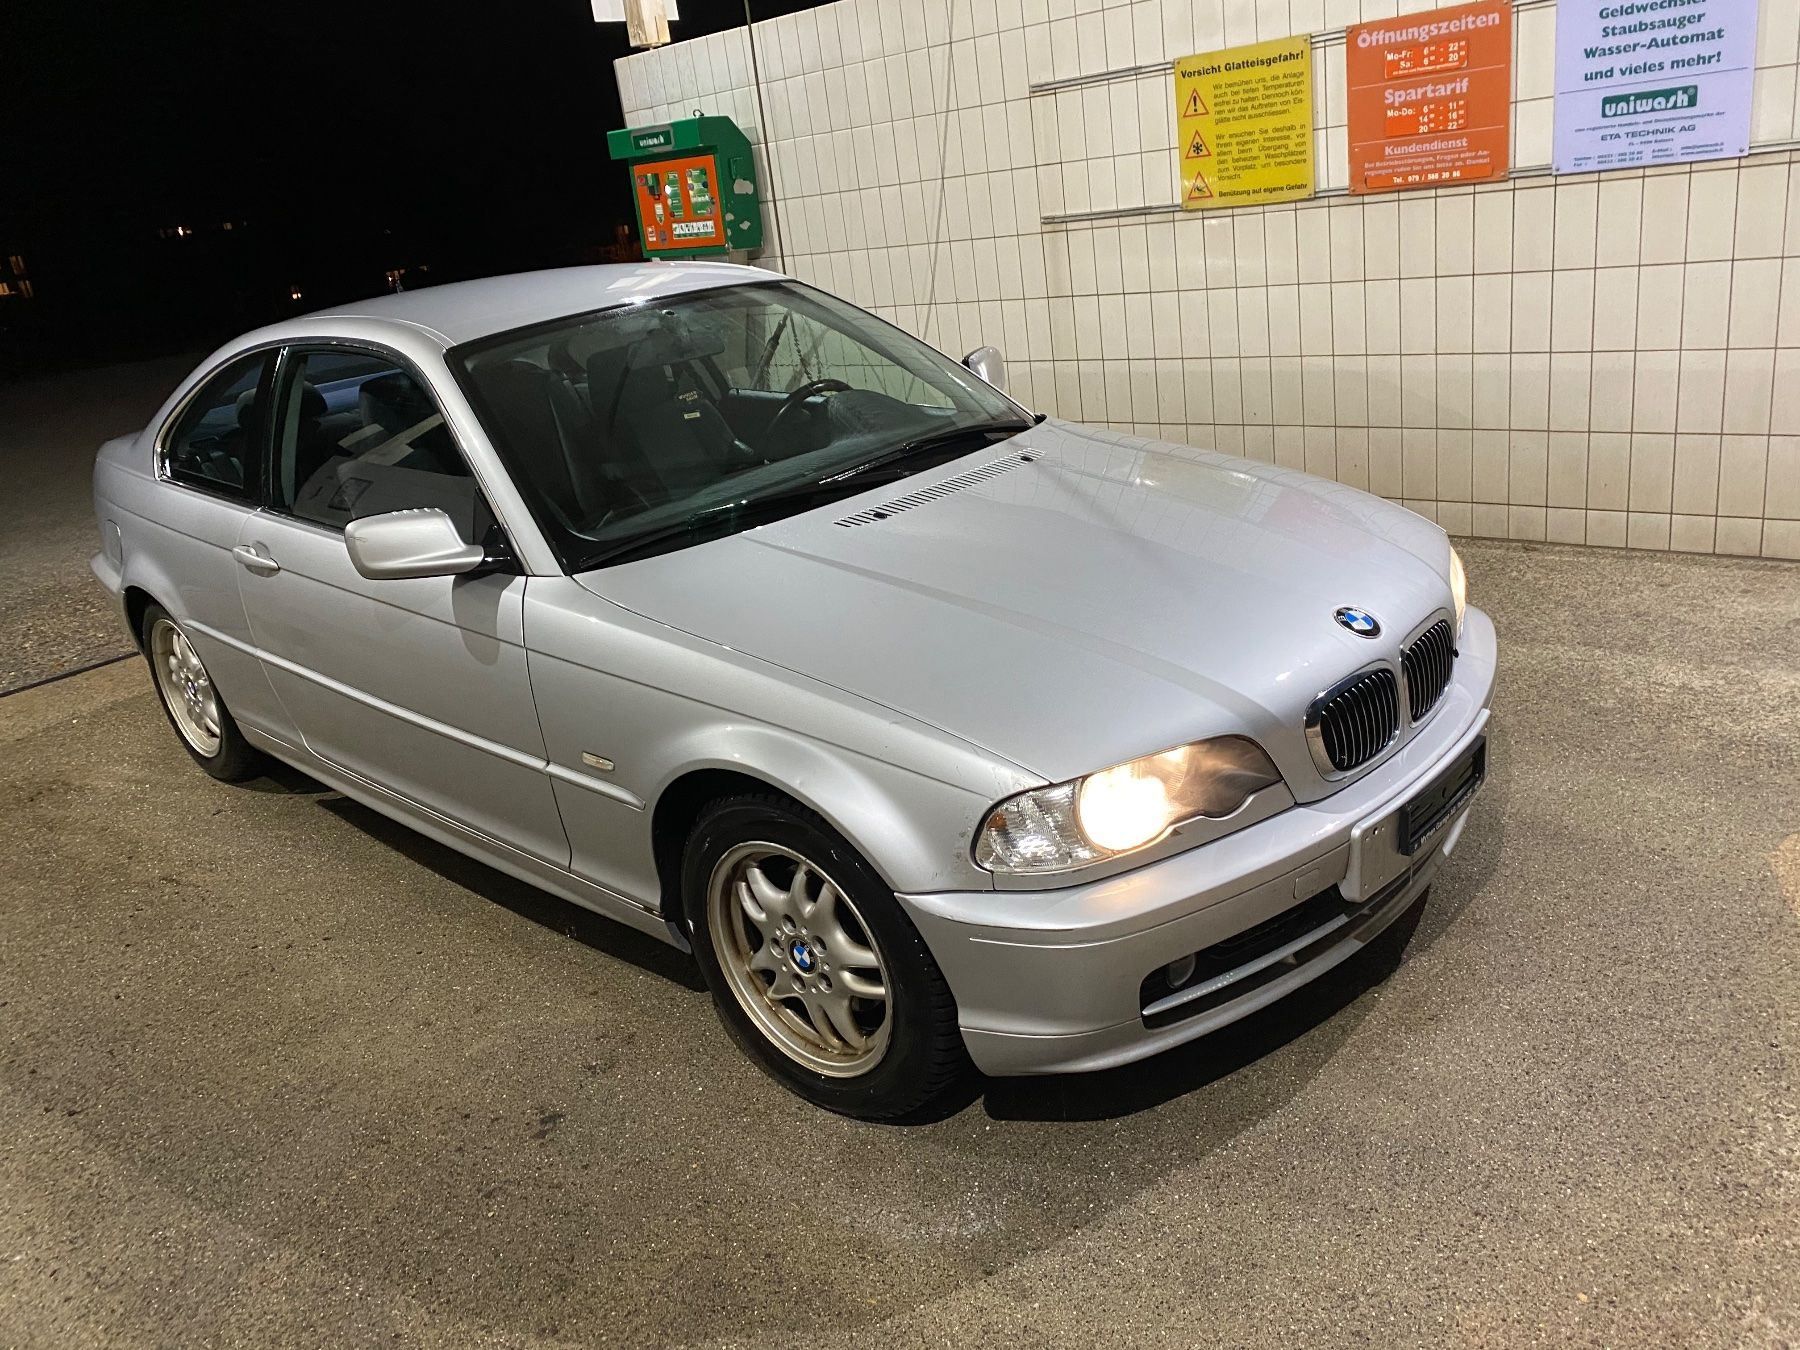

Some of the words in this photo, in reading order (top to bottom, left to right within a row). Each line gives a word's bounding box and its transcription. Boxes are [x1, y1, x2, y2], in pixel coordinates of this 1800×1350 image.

[1357, 12, 1500, 48] Öffnungszeiten
[1602, 12, 1705, 38] Staubsauger
[1584, 27, 1725, 58] Wasser-Automat
[1387, 51, 1413, 60] Mo-Fr:
[1181, 65, 1221, 79] Vorsicht
[1225, 50, 1304, 72] Glatteisgefahr!
[1584, 67, 1614, 81] und
[1619, 61, 1664, 76] vieles
[1671, 51, 1721, 69] mehr!
[1225, 79, 1252, 88] bemühen
[1283, 71, 1304, 79] Anlage
[1214, 91, 1228, 99] auch
[1263, 80, 1304, 91] Temperaturen
[1262, 91, 1289, 100] Dennoch
[1385, 78, 1469, 106] Spartarif
[1251, 101, 1277, 110] Auftreten
[1387, 108, 1415, 117] Mo-Do:
[1232, 113, 1246, 121] nicht
[1229, 130, 1255, 138] ersuchen
[1272, 125, 1296, 133] deshalb
[1601, 133, 1621, 141] ETA
[1624, 126, 1675, 138] TECHNIK
[1680, 124, 1696, 132] AG
[1236, 138, 1259, 147] eigenen
[1258, 143, 1288, 152] Übergang
[1385, 137, 1468, 155] Kundendienst
[1232, 155, 1260, 164] beheizten
[1265, 150, 1306, 159] Waschplätzen
[1274, 158, 1307, 167] besondere
[1219, 189, 1250, 197] Benützung
[1263, 185, 1284, 193] eigene
